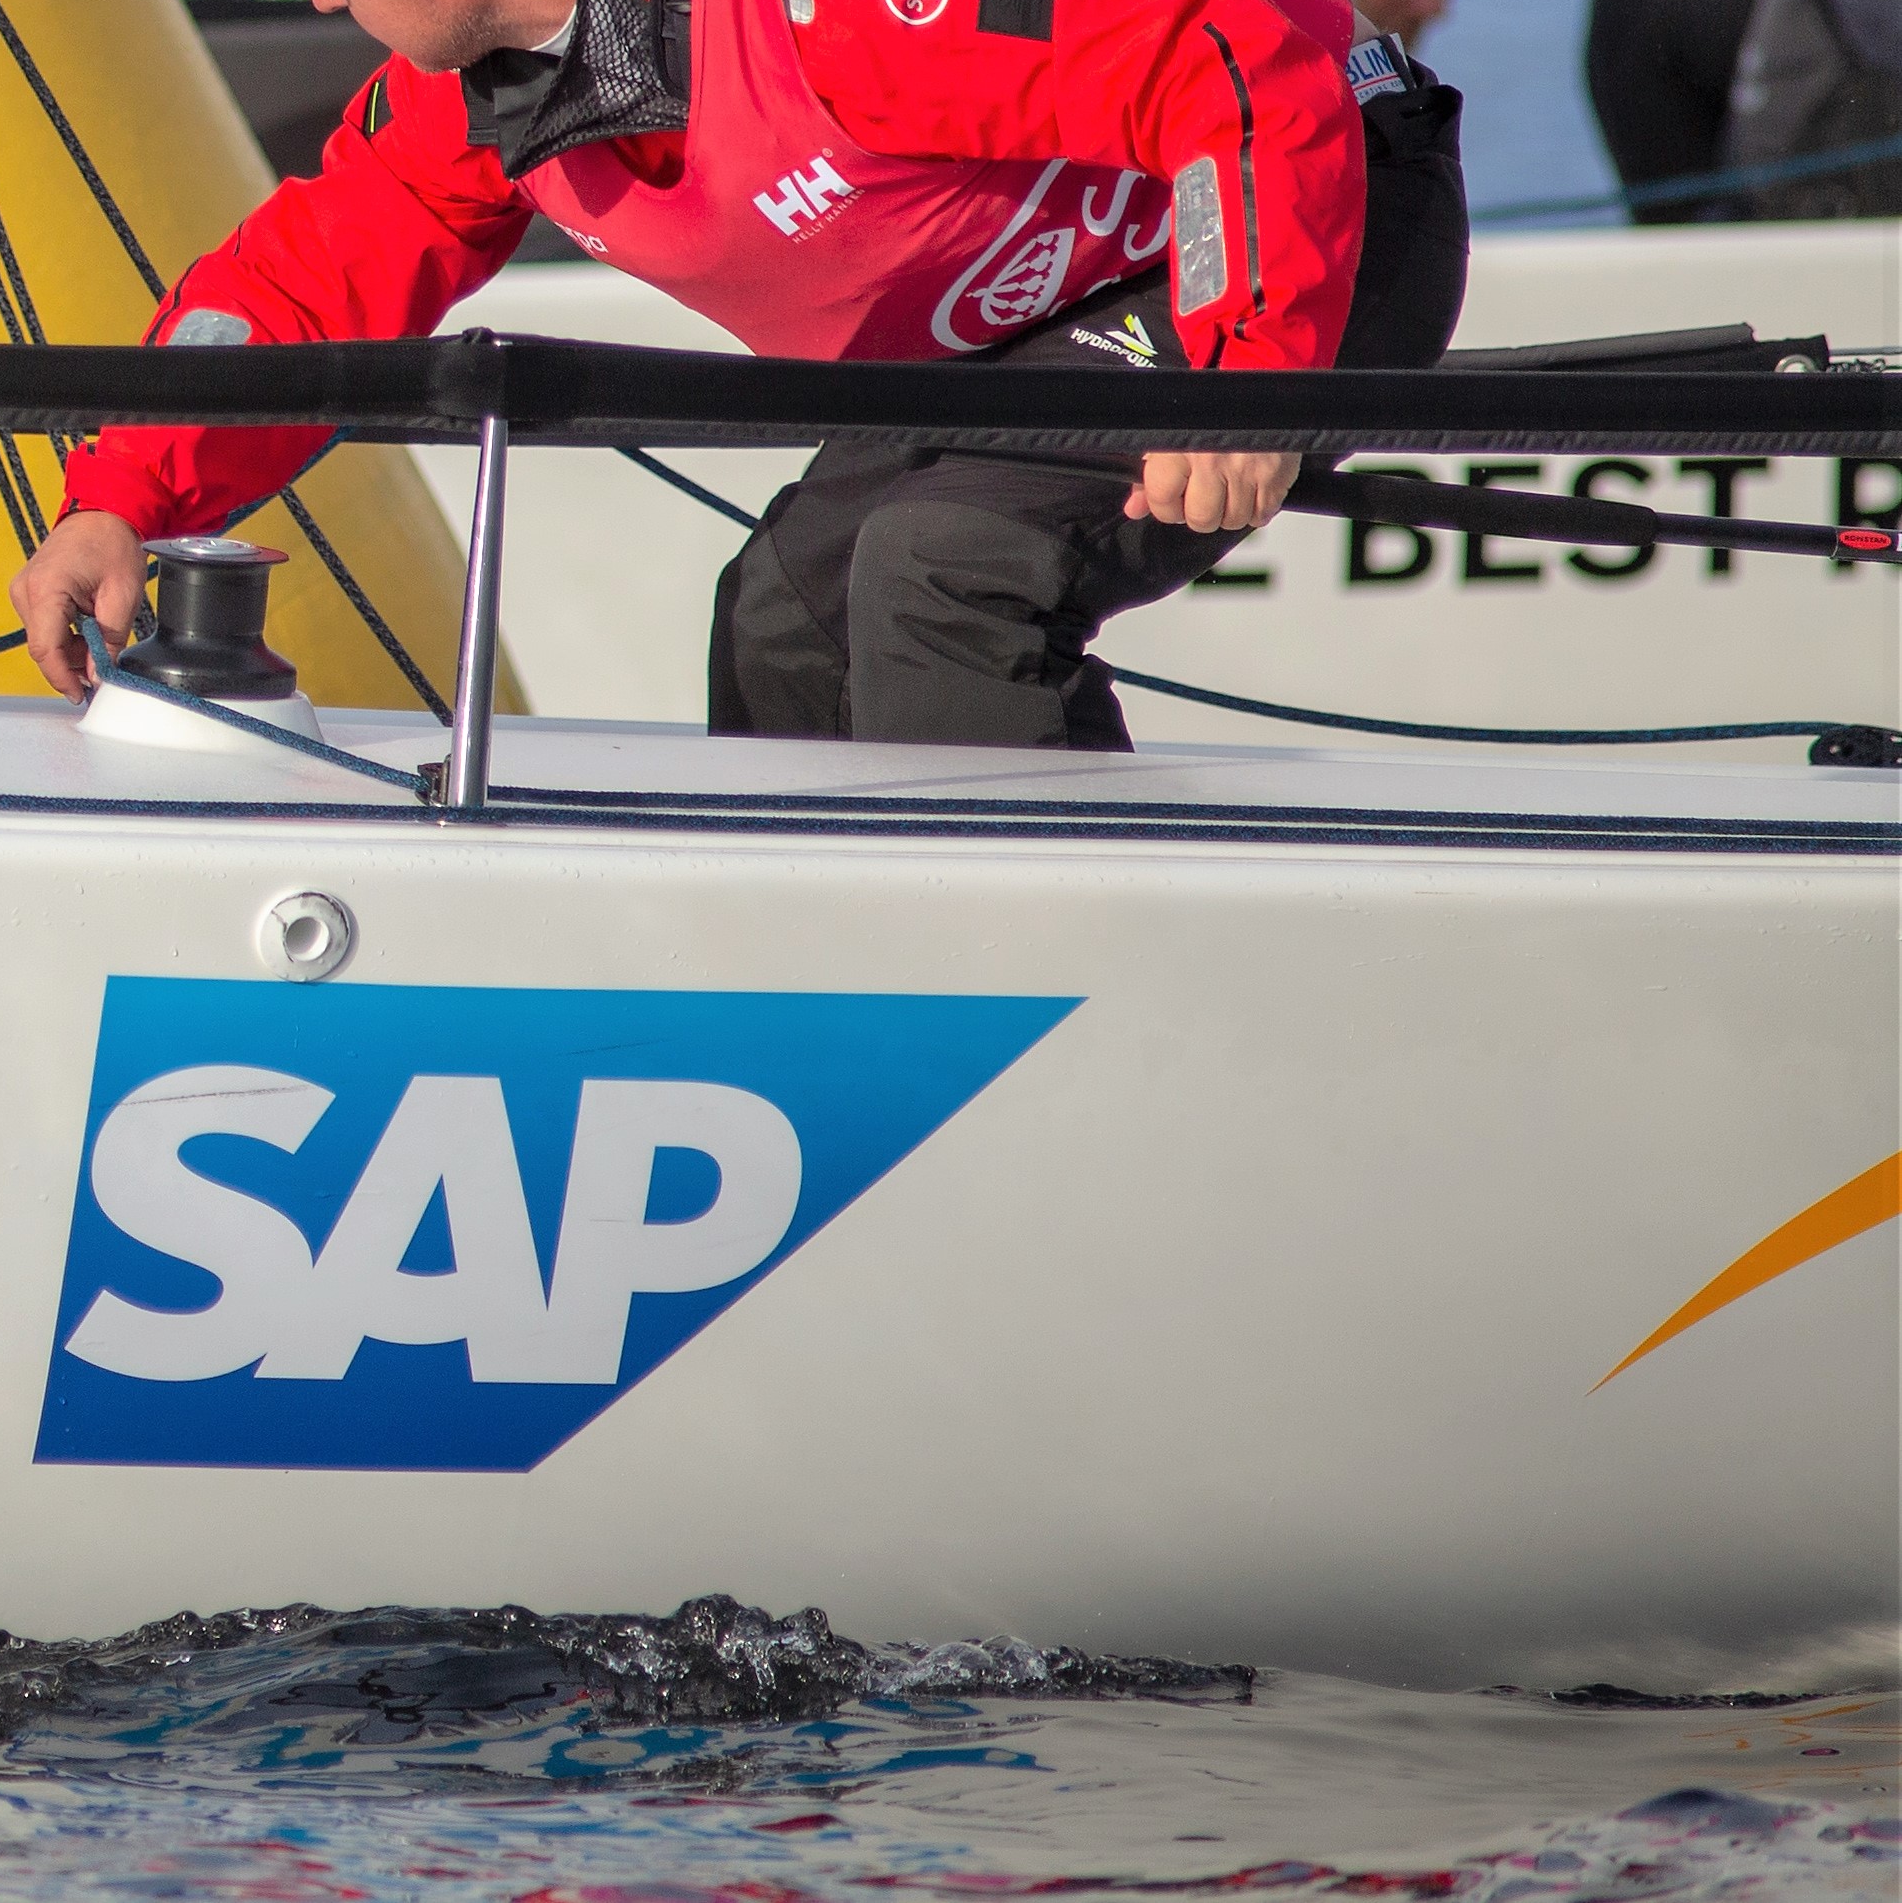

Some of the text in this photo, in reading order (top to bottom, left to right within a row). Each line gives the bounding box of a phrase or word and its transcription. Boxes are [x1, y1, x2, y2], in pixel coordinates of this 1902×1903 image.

[752, 156, 856, 237] HH
[792, 221, 825, 244] HELLY
[1070, 328, 1158, 368] HYDROPOW
[1844, 535, 1887, 544] RONSTAN
[64, 1064, 803, 1385] SAP
